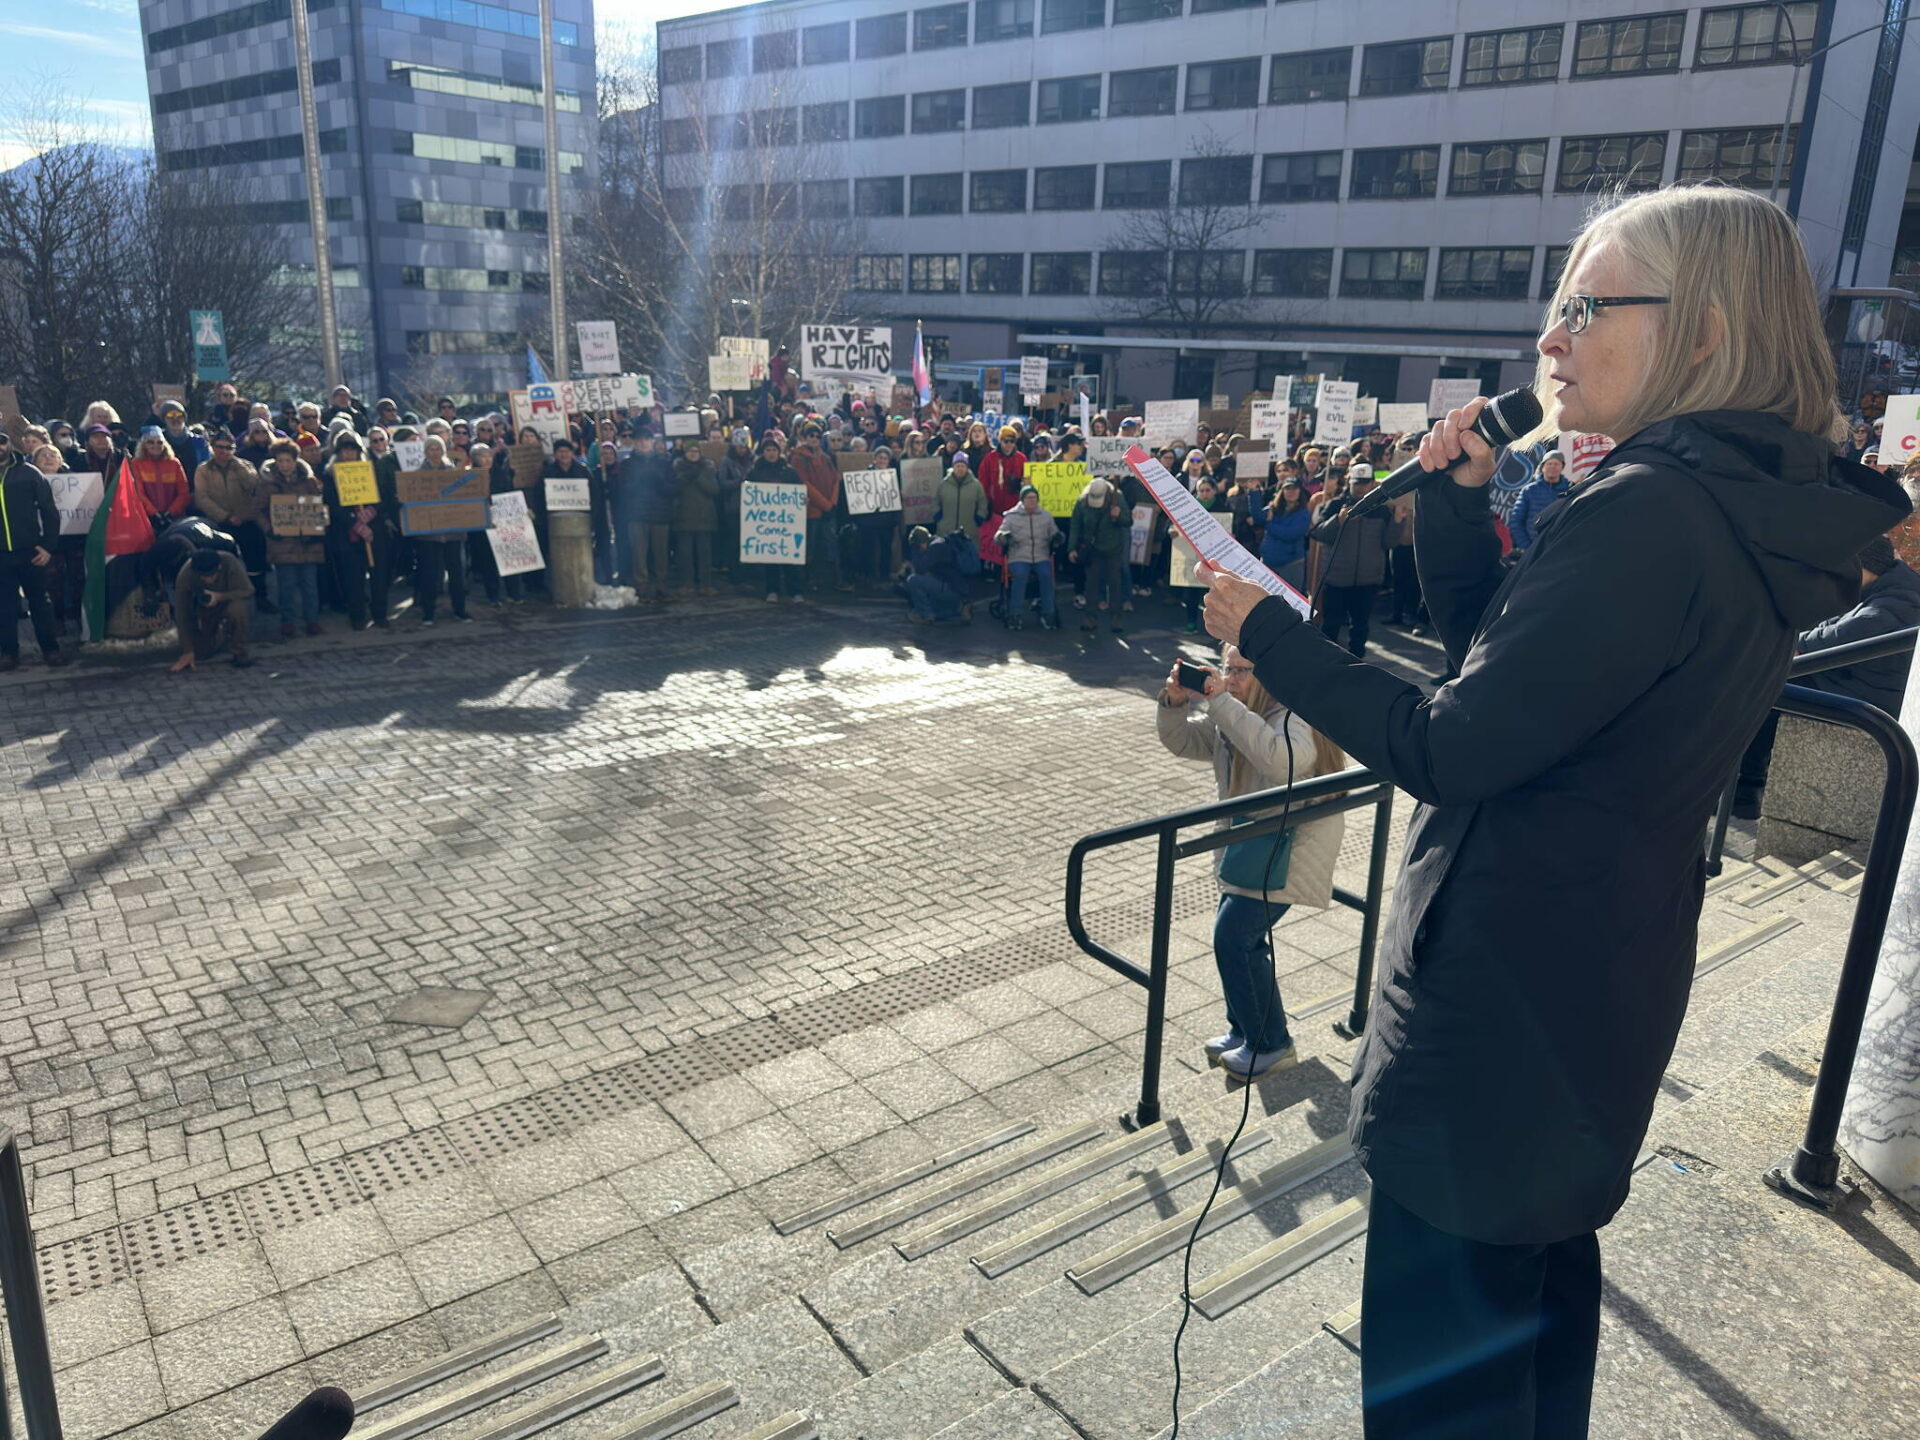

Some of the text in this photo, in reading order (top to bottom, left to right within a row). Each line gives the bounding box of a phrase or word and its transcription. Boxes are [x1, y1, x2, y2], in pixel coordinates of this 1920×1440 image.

[807, 326, 875, 344] HAVE
[812, 341, 889, 373] RIGHTS
[562, 387, 612, 404] OVER
[563, 398, 640, 412] PEOPLE
[845, 471, 895, 494] RESIST
[744, 485, 809, 511] Students
[865, 488, 899, 511] COUP
[745, 509, 795, 524] Needs
